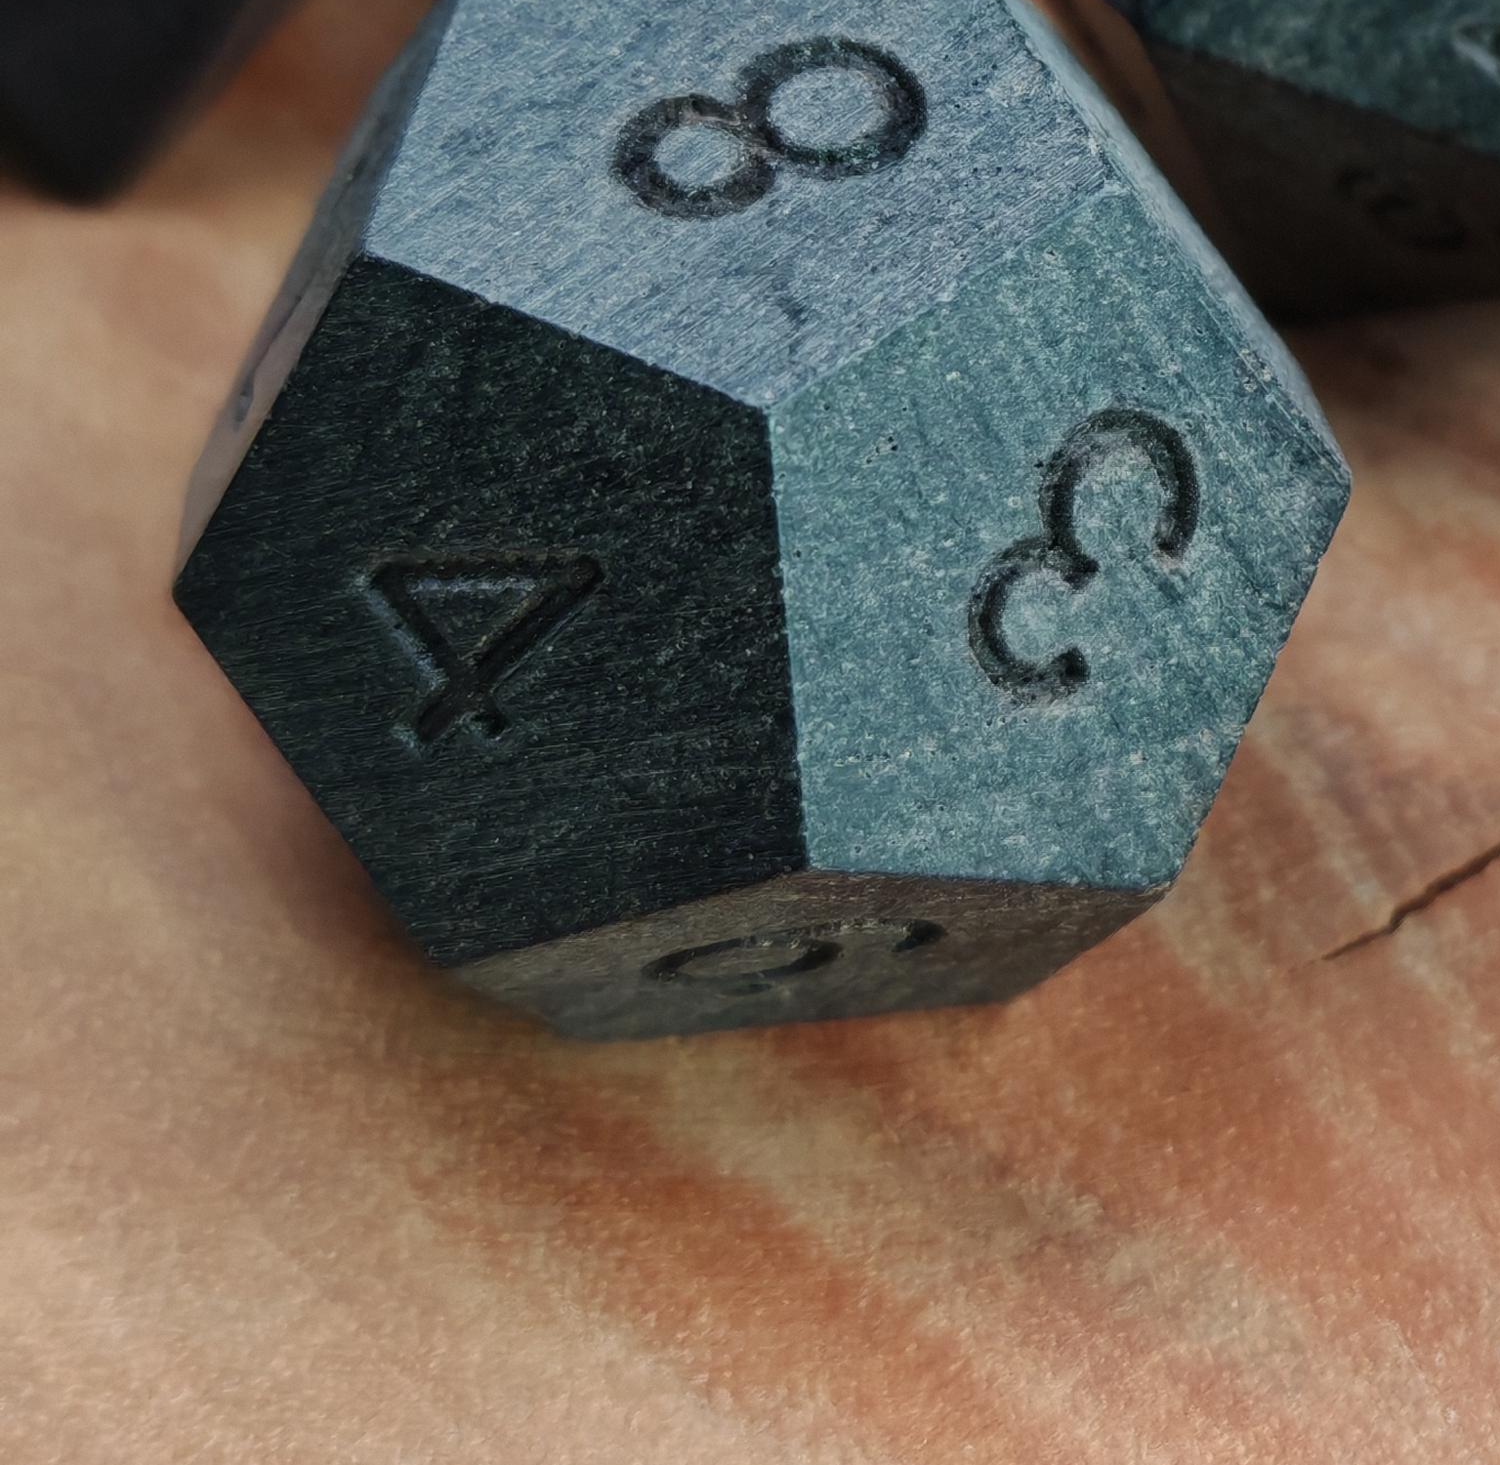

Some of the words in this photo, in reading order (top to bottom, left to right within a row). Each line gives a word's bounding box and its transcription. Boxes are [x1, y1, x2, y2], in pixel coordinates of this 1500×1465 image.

[611, 33, 930, 222] 8
[365, 548, 602, 740] 4
[968, 406, 1201, 708] 3
